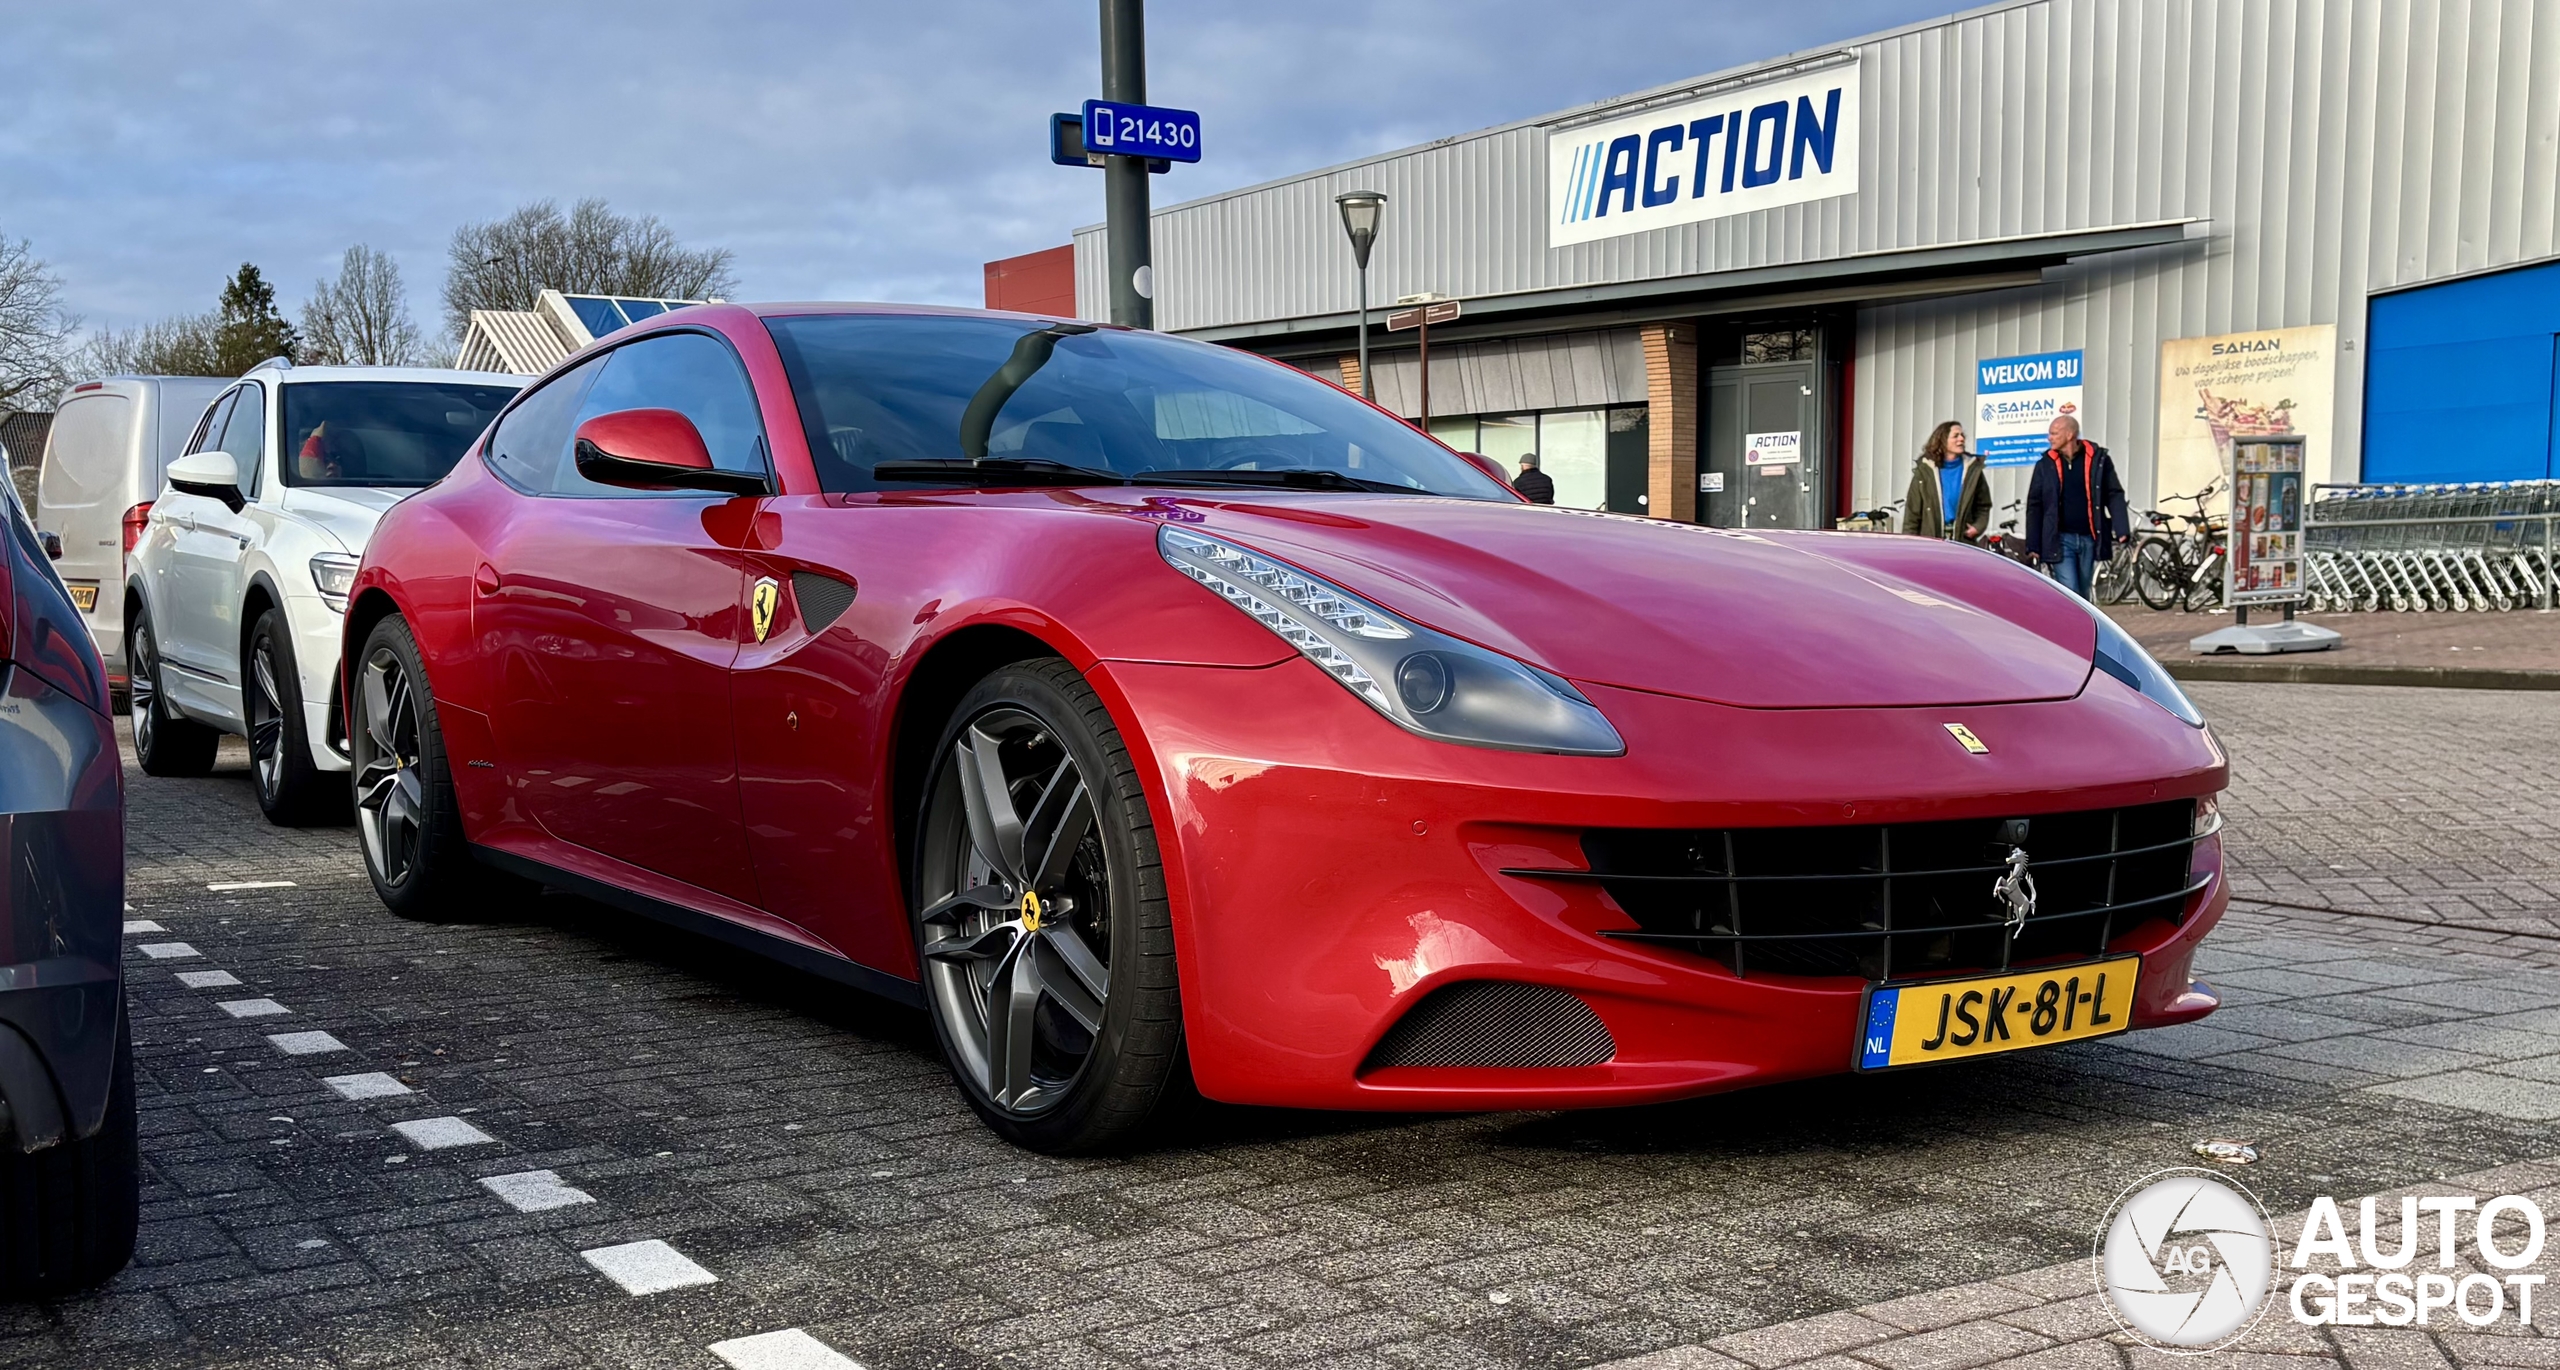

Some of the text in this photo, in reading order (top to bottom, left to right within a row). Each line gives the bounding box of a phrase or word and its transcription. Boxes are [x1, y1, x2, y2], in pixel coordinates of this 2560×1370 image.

[1120, 117, 1195, 148] 21430
[1595, 88, 1842, 218] ACTION
[2212, 338, 2280, 355] SAHAN
[1982, 358, 2079, 386] WELKOM BIJ
[2193, 357, 2242, 377] dagelijkse
[2244, 350, 2319, 369] boodschappen,
[2195, 377, 2214, 388] voor
[2216, 370, 2254, 385] scherpe
[1998, 398, 2054, 413] SAHAN
[1755, 434, 1798, 448] ACTION
[1921, 973, 2111, 1050] JSK-81-L
[1866, 1037, 1887, 1054] NL
